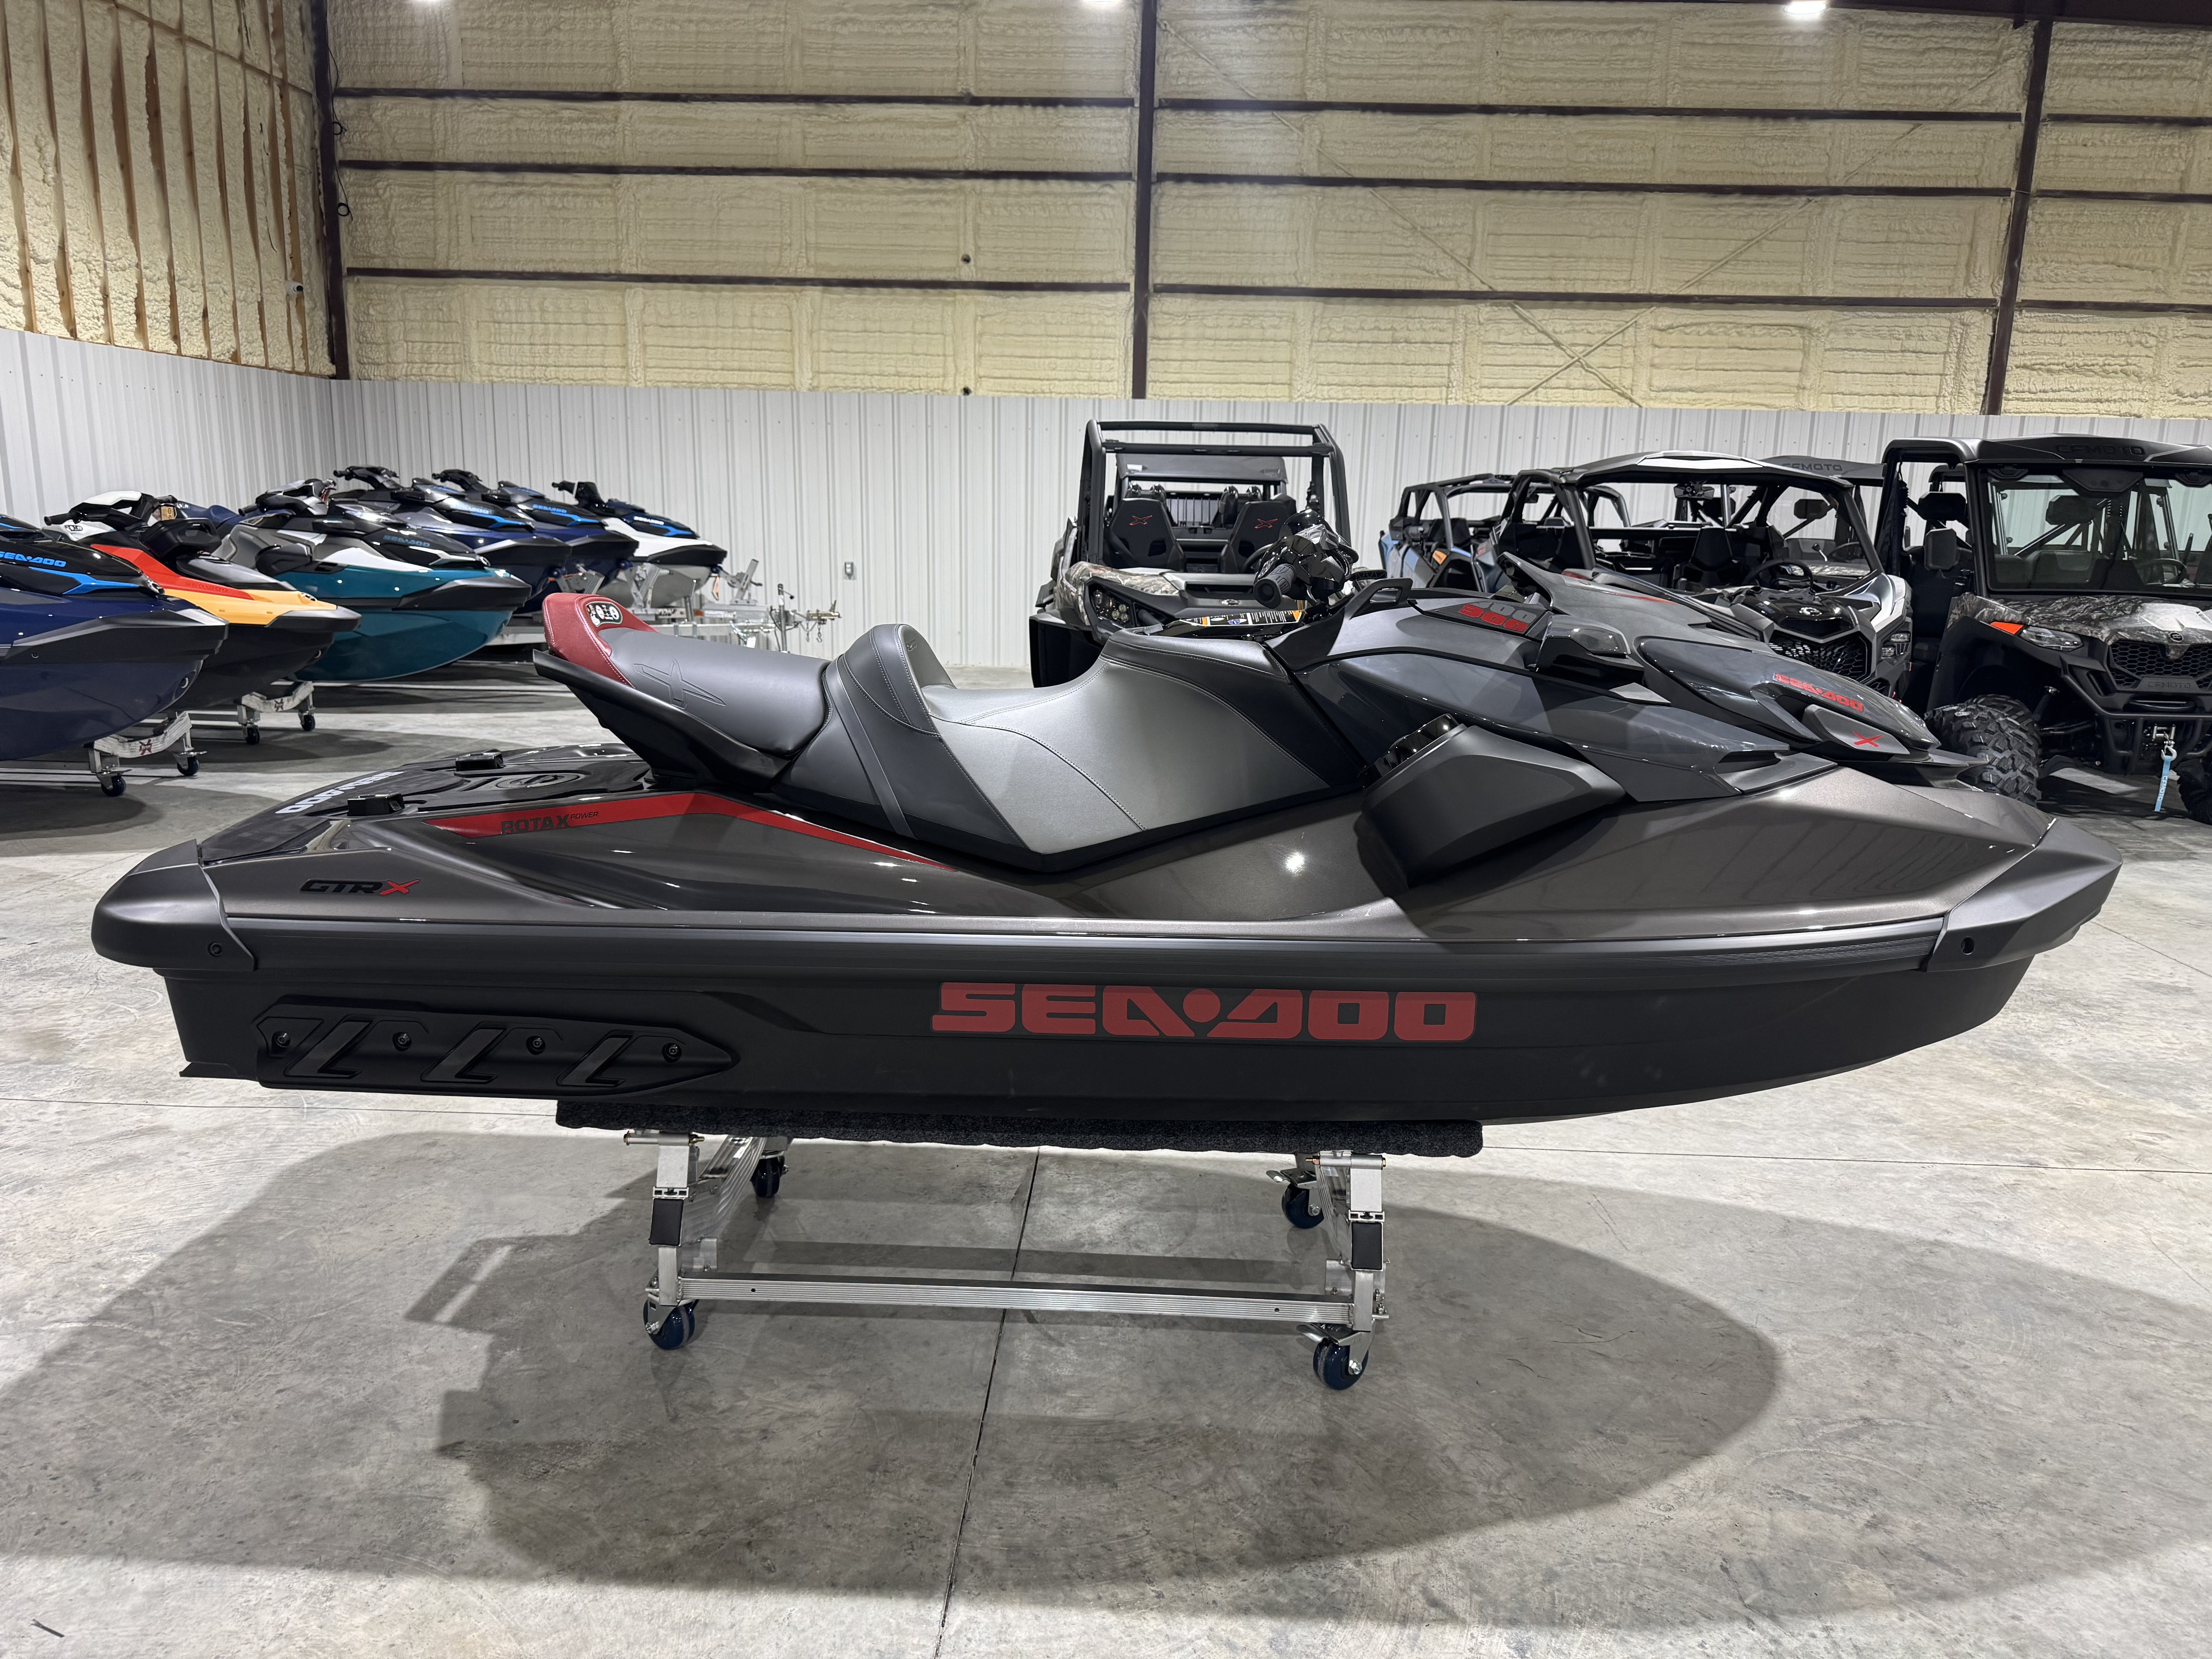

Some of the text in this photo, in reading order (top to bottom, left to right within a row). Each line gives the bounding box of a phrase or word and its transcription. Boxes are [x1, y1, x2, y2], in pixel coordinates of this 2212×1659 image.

[1458, 603, 1528, 632] 300
[501, 811, 599, 835] ROTAX POWER
